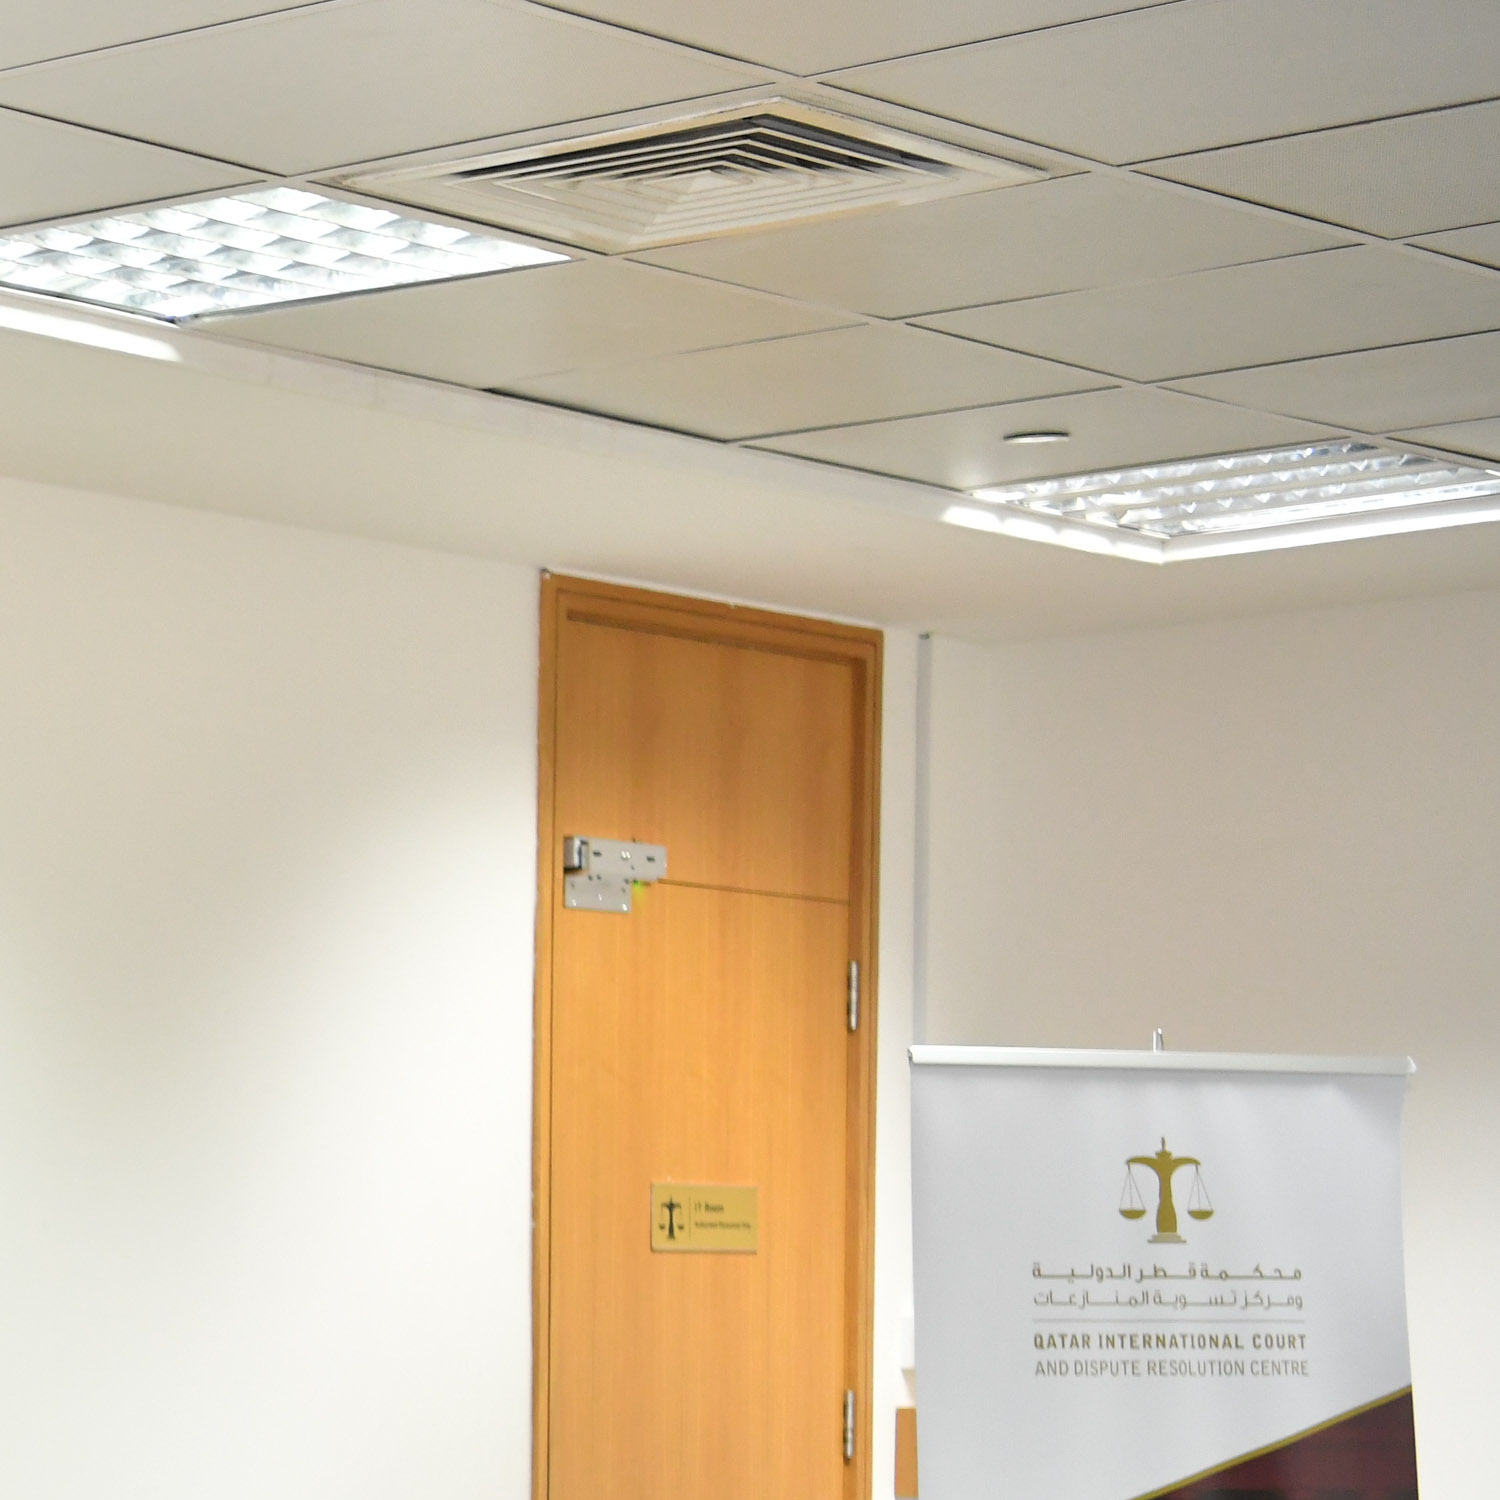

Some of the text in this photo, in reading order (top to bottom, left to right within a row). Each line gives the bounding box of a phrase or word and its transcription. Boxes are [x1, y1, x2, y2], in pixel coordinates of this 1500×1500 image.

[1033, 1262, 1302, 1283] محكمة قطر الدولية
[1034, 1288, 1303, 1311] ومركز تسوية المنازعات
[1034, 1333, 1306, 1350] QATAR INTERNATIONAL COURT
[1035, 1360, 1309, 1376] AND DISPUTE RESOLUTION CENTRE
